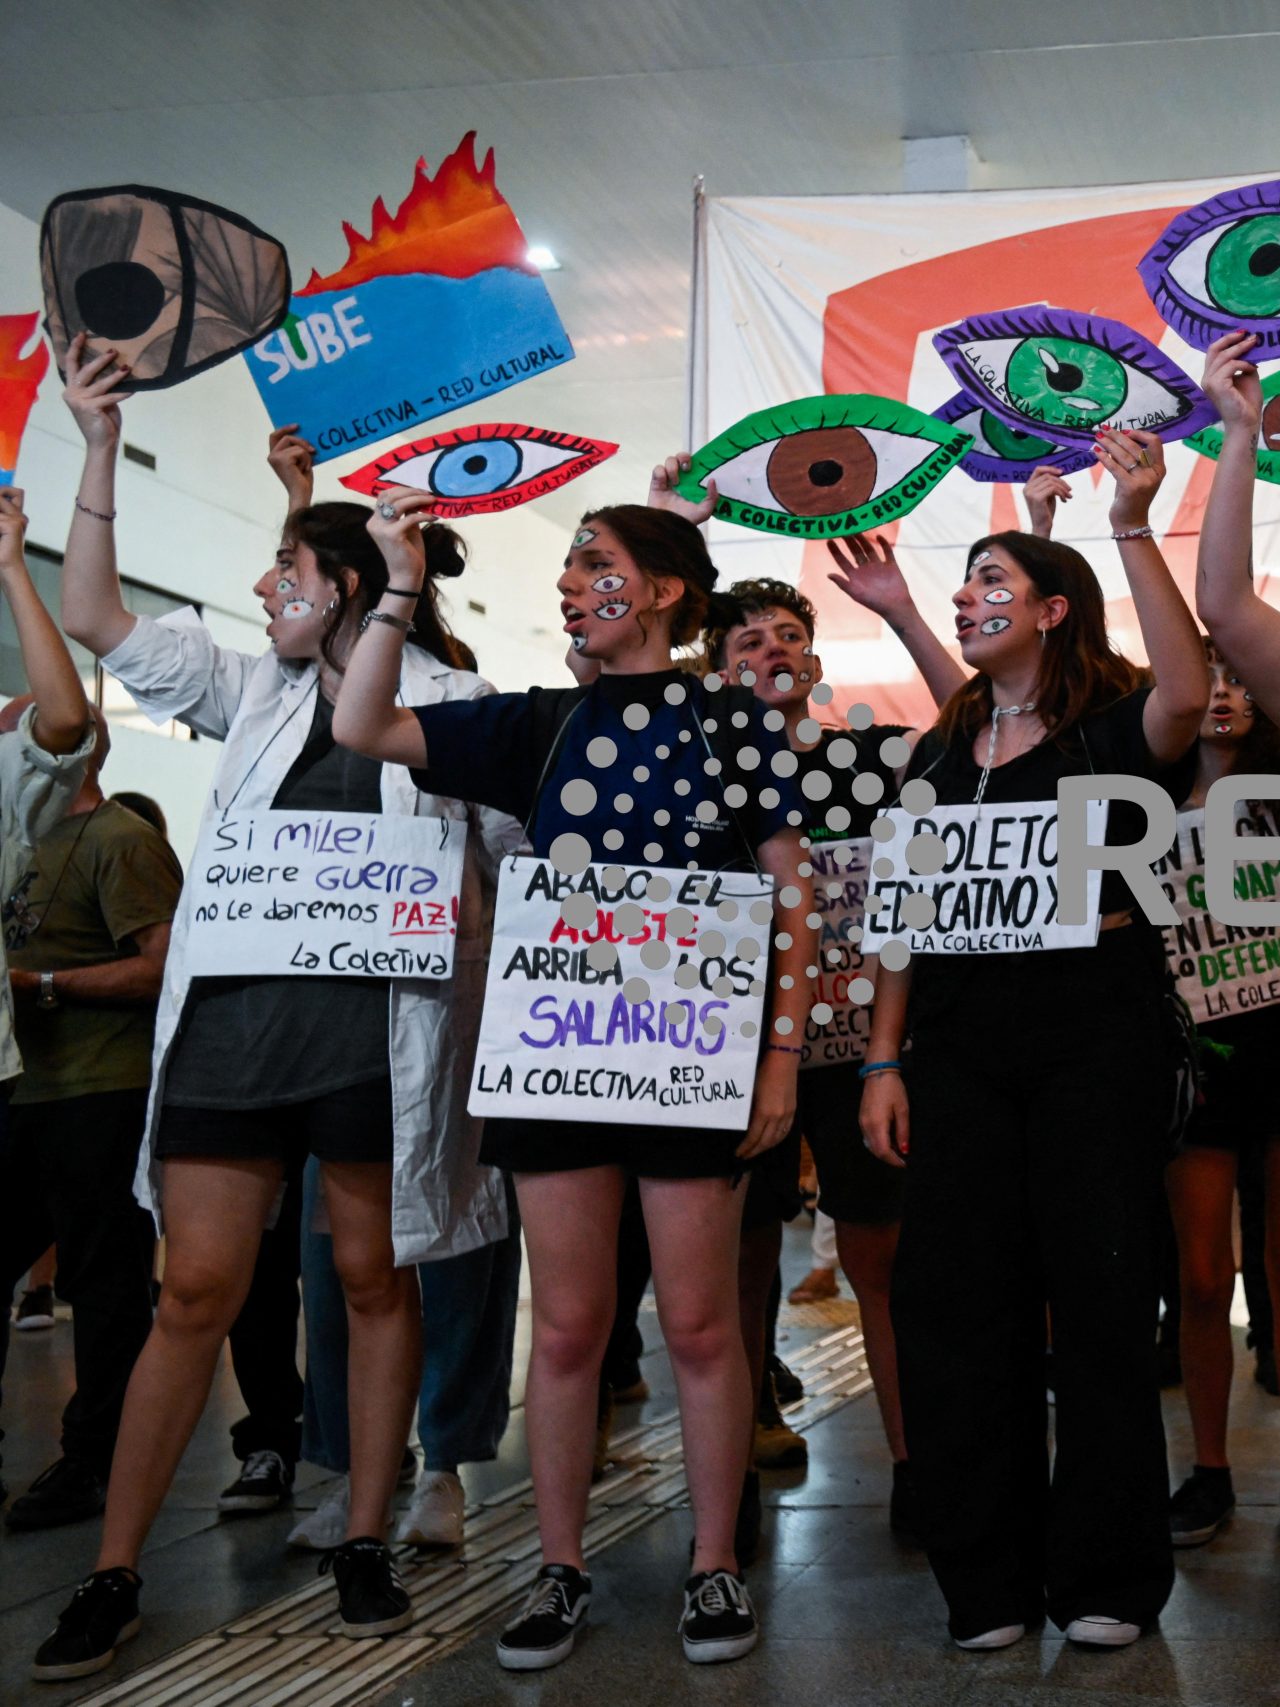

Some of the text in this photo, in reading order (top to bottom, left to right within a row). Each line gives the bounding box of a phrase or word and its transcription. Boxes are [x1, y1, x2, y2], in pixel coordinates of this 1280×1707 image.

[254, 296, 373, 384] SUBE
[964, 347, 981, 367] LA
[317, 400, 418, 451] COLECTIVA
[438, 377, 474, 405] RED
[480, 344, 564, 387] CULTURAL
[740, 508, 858, 534] COLECTIVA
[874, 495, 902, 519] RED
[901, 432, 975, 499] CULTURAL
[677, 874, 724, 907] EL
[263, 897, 379, 923] daremos
[390, 895, 459, 935] PAZ!
[290, 942, 320, 969] La
[911, 932, 1043, 951] LA COLECTIVA
[503, 946, 623, 985] ARRIBA
[1204, 991, 1229, 1017] LA
[519, 992, 729, 1056] SALARIOS
[477, 1064, 705, 1102] LA COLECTIVA RED
[659, 1079, 744, 1107] CULTURAL
